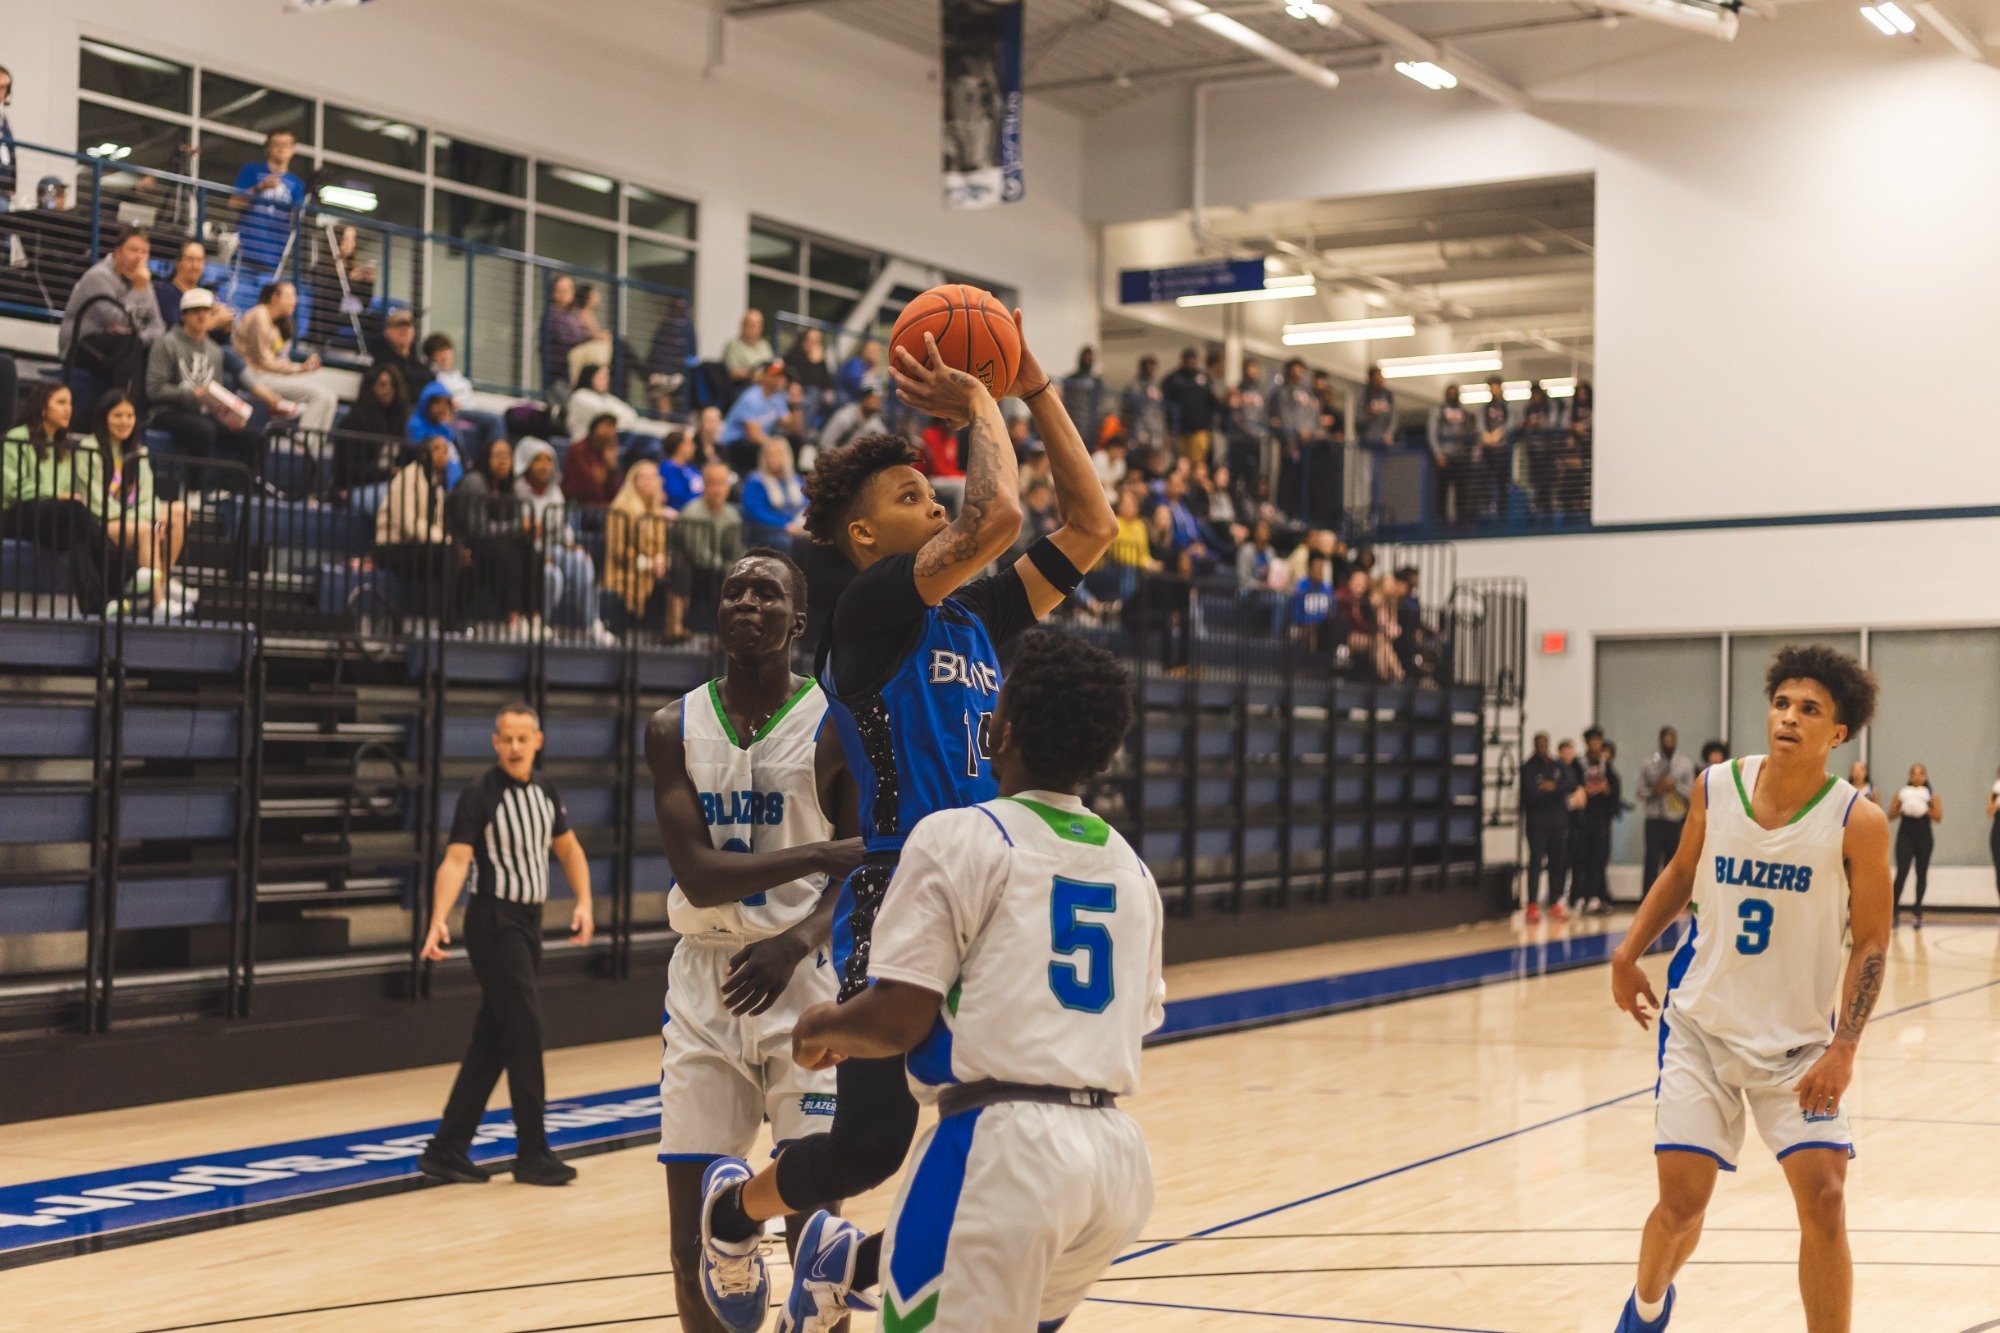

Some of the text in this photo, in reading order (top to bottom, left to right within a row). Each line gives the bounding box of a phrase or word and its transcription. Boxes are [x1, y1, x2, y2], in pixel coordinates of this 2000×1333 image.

[1715, 855, 1813, 893] BLAZERS
[1048, 874, 1116, 1014] 5
[1735, 898, 1774, 955] 3
[803, 1100, 837, 1111] BLAZER
